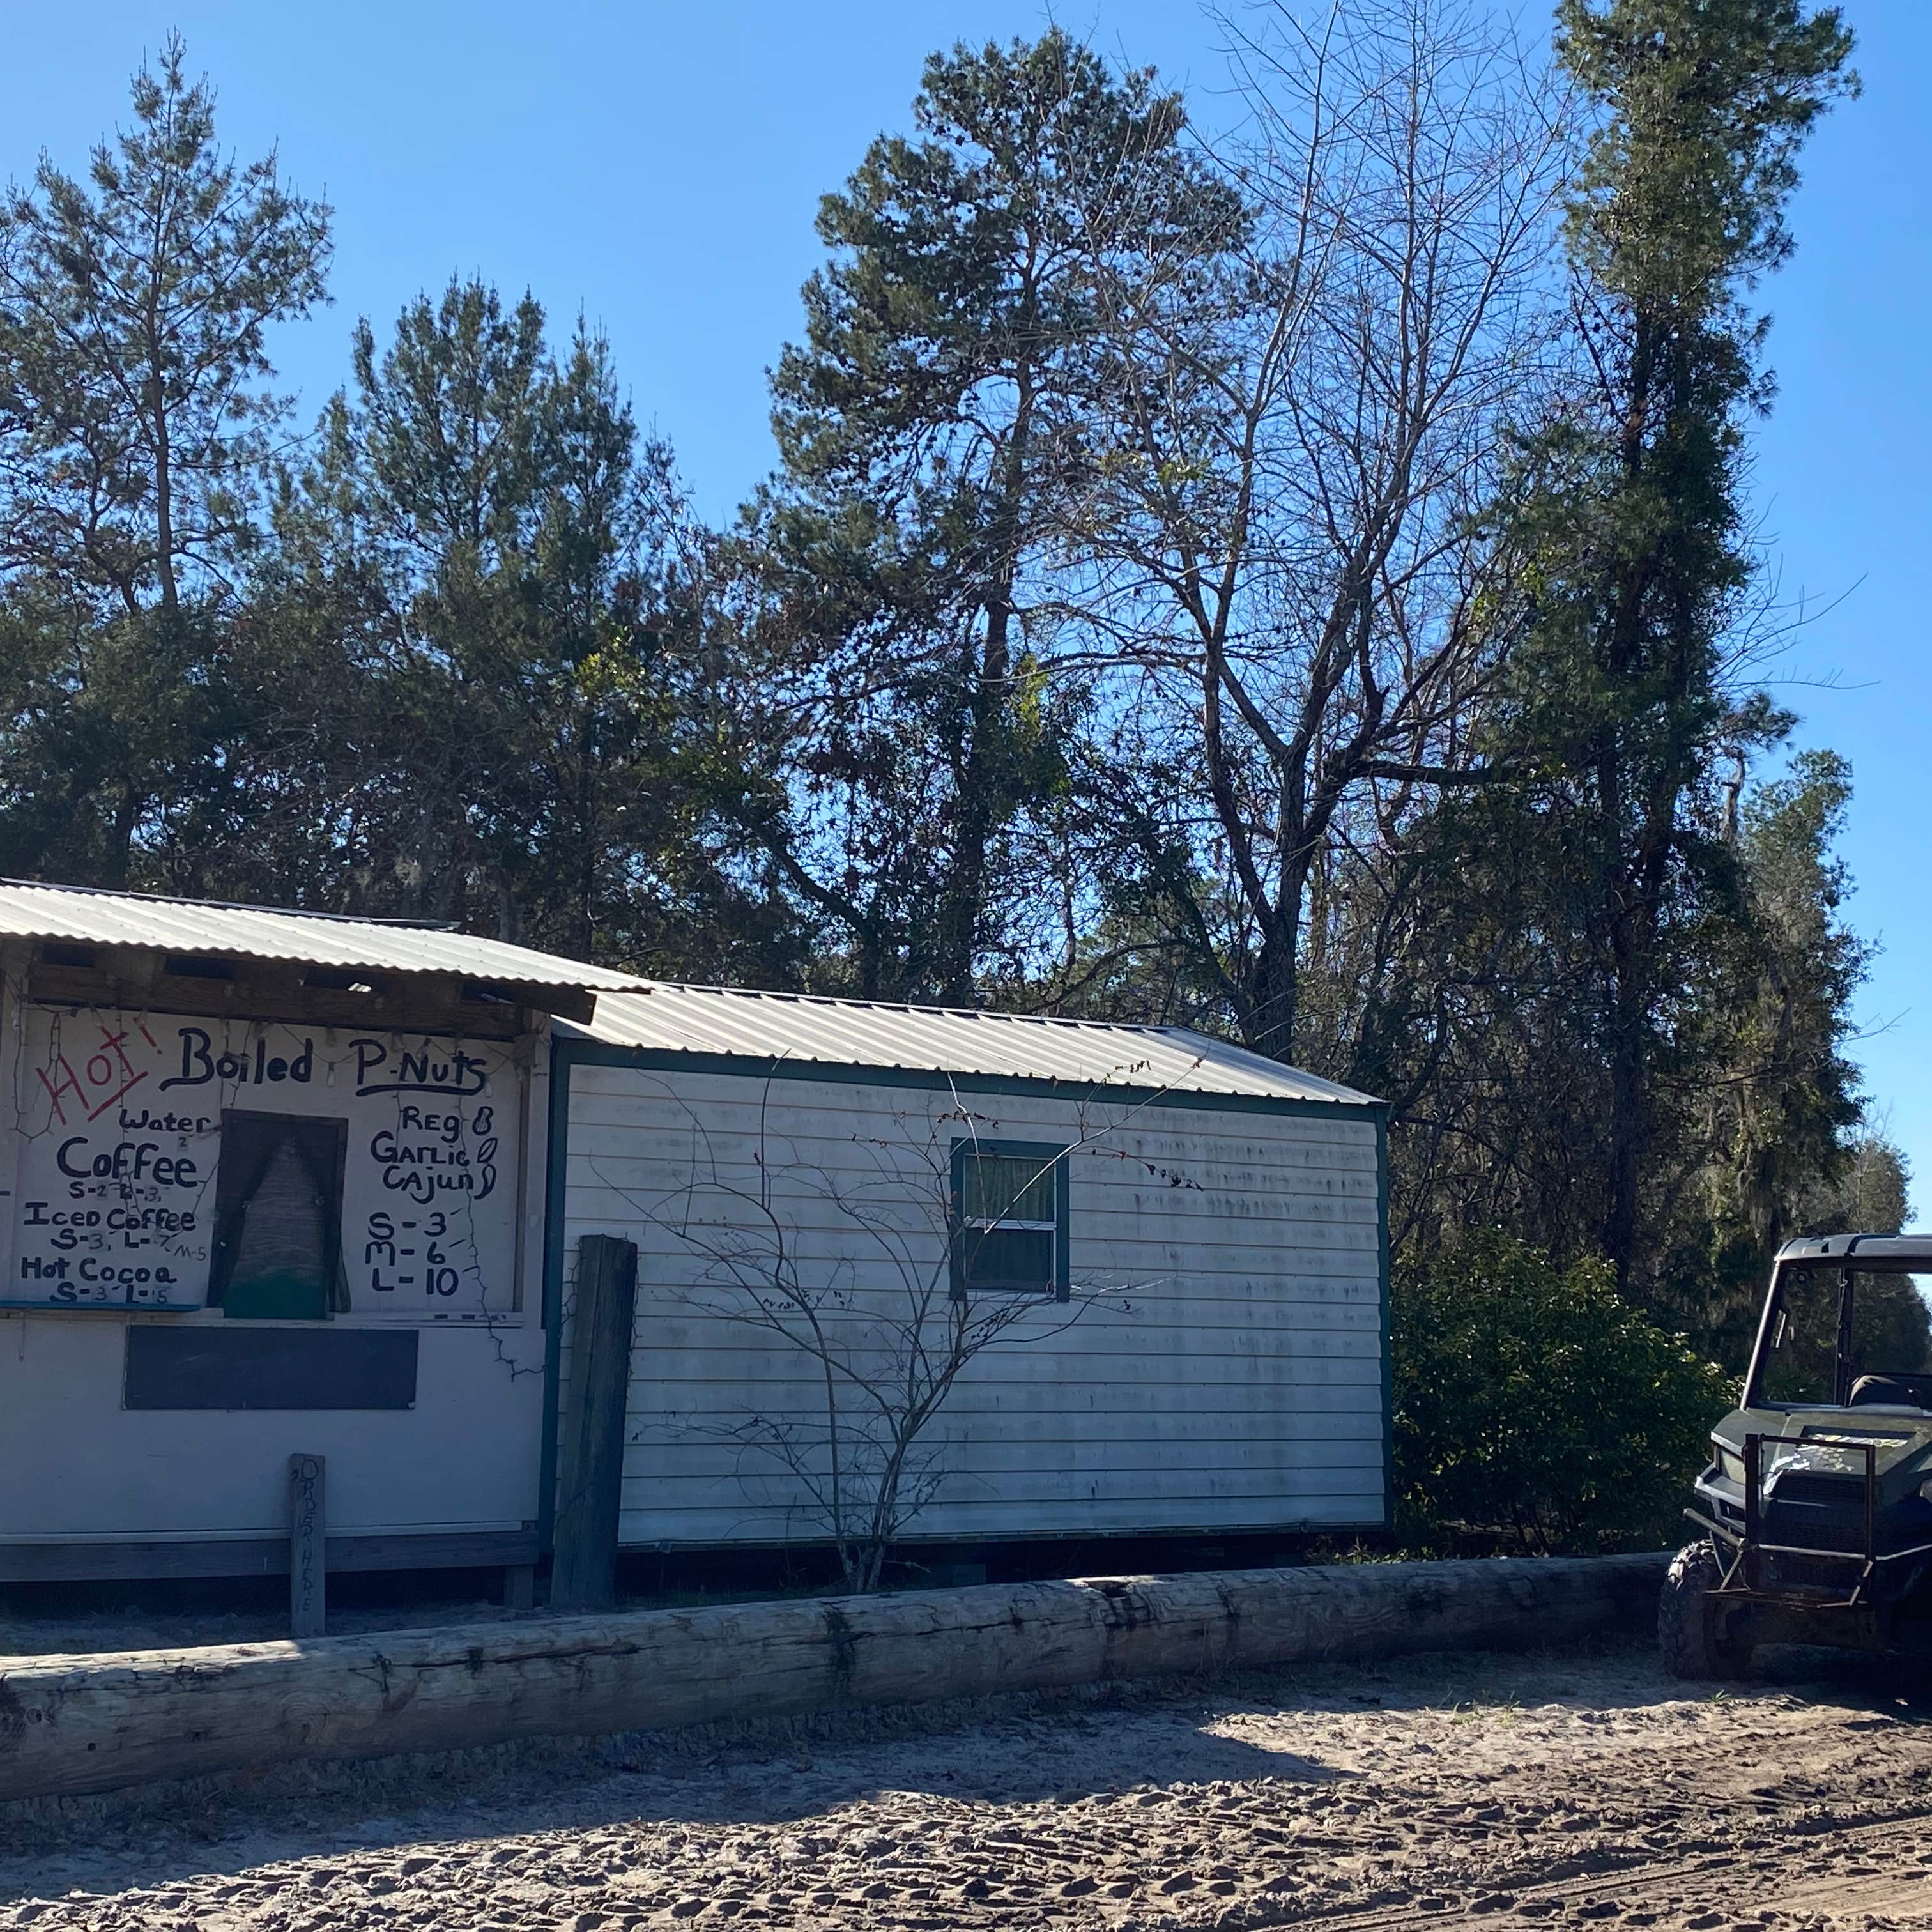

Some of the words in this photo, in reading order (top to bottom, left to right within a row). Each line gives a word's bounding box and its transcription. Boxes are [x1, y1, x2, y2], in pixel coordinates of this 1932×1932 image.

[159, 1027, 313, 1091] Boiled
[349, 1039, 487, 1096] P-Nuts
[119, 1109, 211, 1133] Water
[57, 1136, 197, 1188] Coffee
[107, 1208, 196, 1232] Coffee
[21, 1257, 70, 1278] Hot
[79, 1257, 178, 1284] Cocoa
[300, 1459, 318, 1542] ORDER
[301, 1550, 314, 1611] HERE
